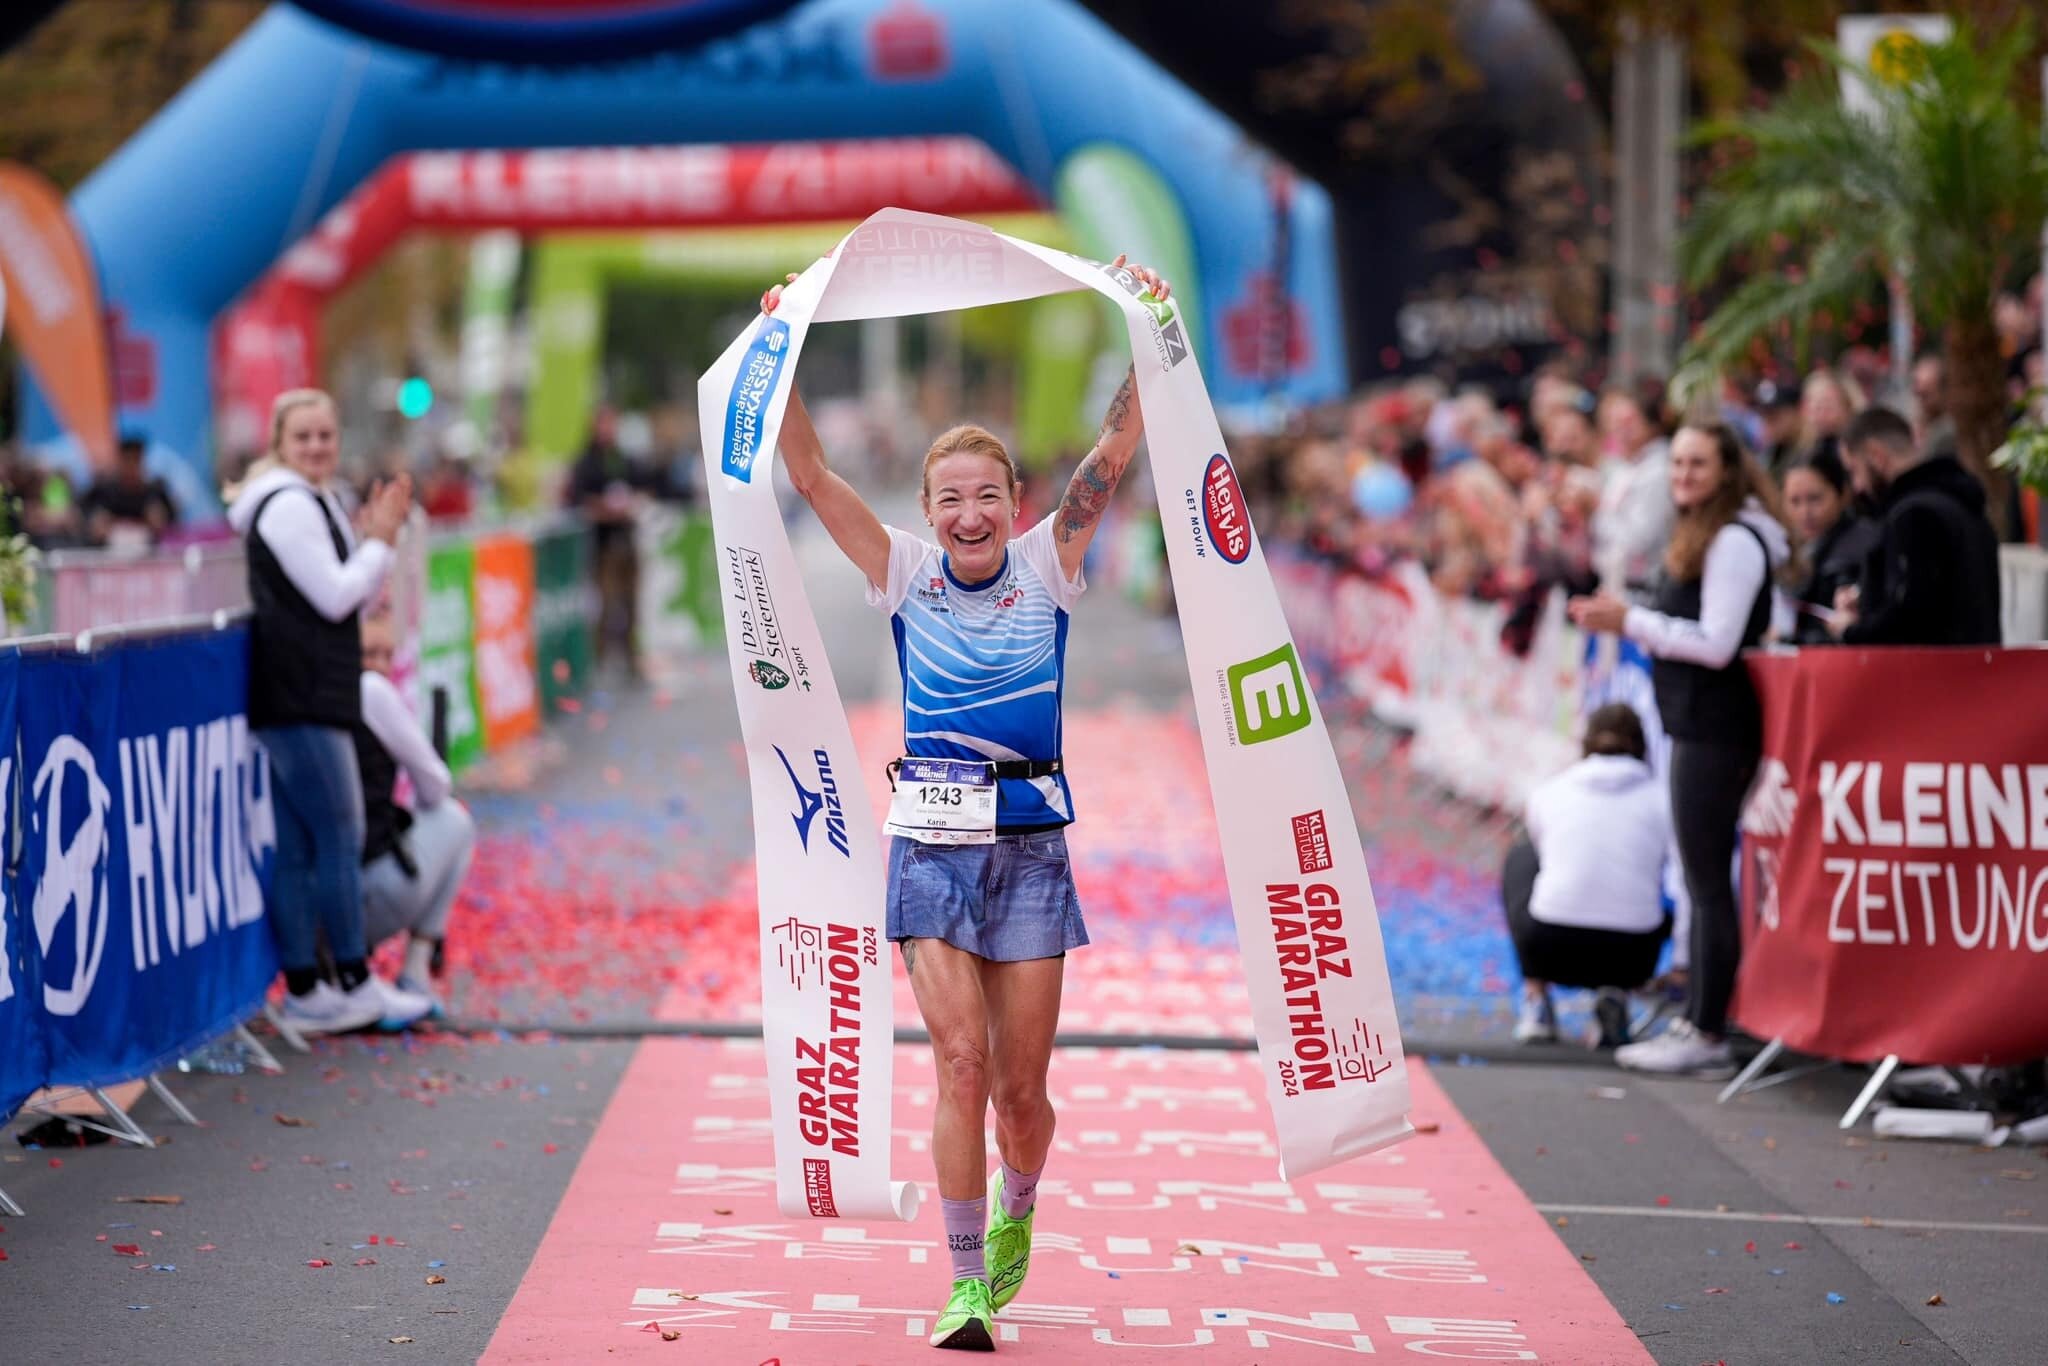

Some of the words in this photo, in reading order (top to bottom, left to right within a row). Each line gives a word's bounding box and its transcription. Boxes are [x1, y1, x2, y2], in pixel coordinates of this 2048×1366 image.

[731, 351, 766, 465] Steiermärkische
[739, 354, 778, 471] SPARKASSE
[1185, 488, 1197, 511] GET
[1207, 484, 1221, 519] SPORTS
[1211, 463, 1244, 556] Hervis
[726, 546, 746, 601] Land
[740, 610, 757, 648] Das
[745, 555, 784, 659] Steiermark
[791, 647, 808, 677] Sport
[814, 749, 850, 859] MIZUNO
[919, 786, 962, 806] 1243
[927, 818, 947, 828] Karin
[1295, 817, 1316, 871] ZEITUNG
[1308, 814, 1329, 868] KLEINE
[863, 926, 877, 966] 2024
[1303, 883, 1353, 979] GRAZ
[1265, 882, 1337, 1091] MARATHON
[827, 923, 861, 1158] MARATHON
[796, 1036, 829, 1147] GRAZ
[1278, 1059, 1299, 1097] 2024
[806, 1161, 824, 1216] KLEINE
[816, 1162, 837, 1217] ZEITUNG
[948, 1232, 980, 1243] STAY
